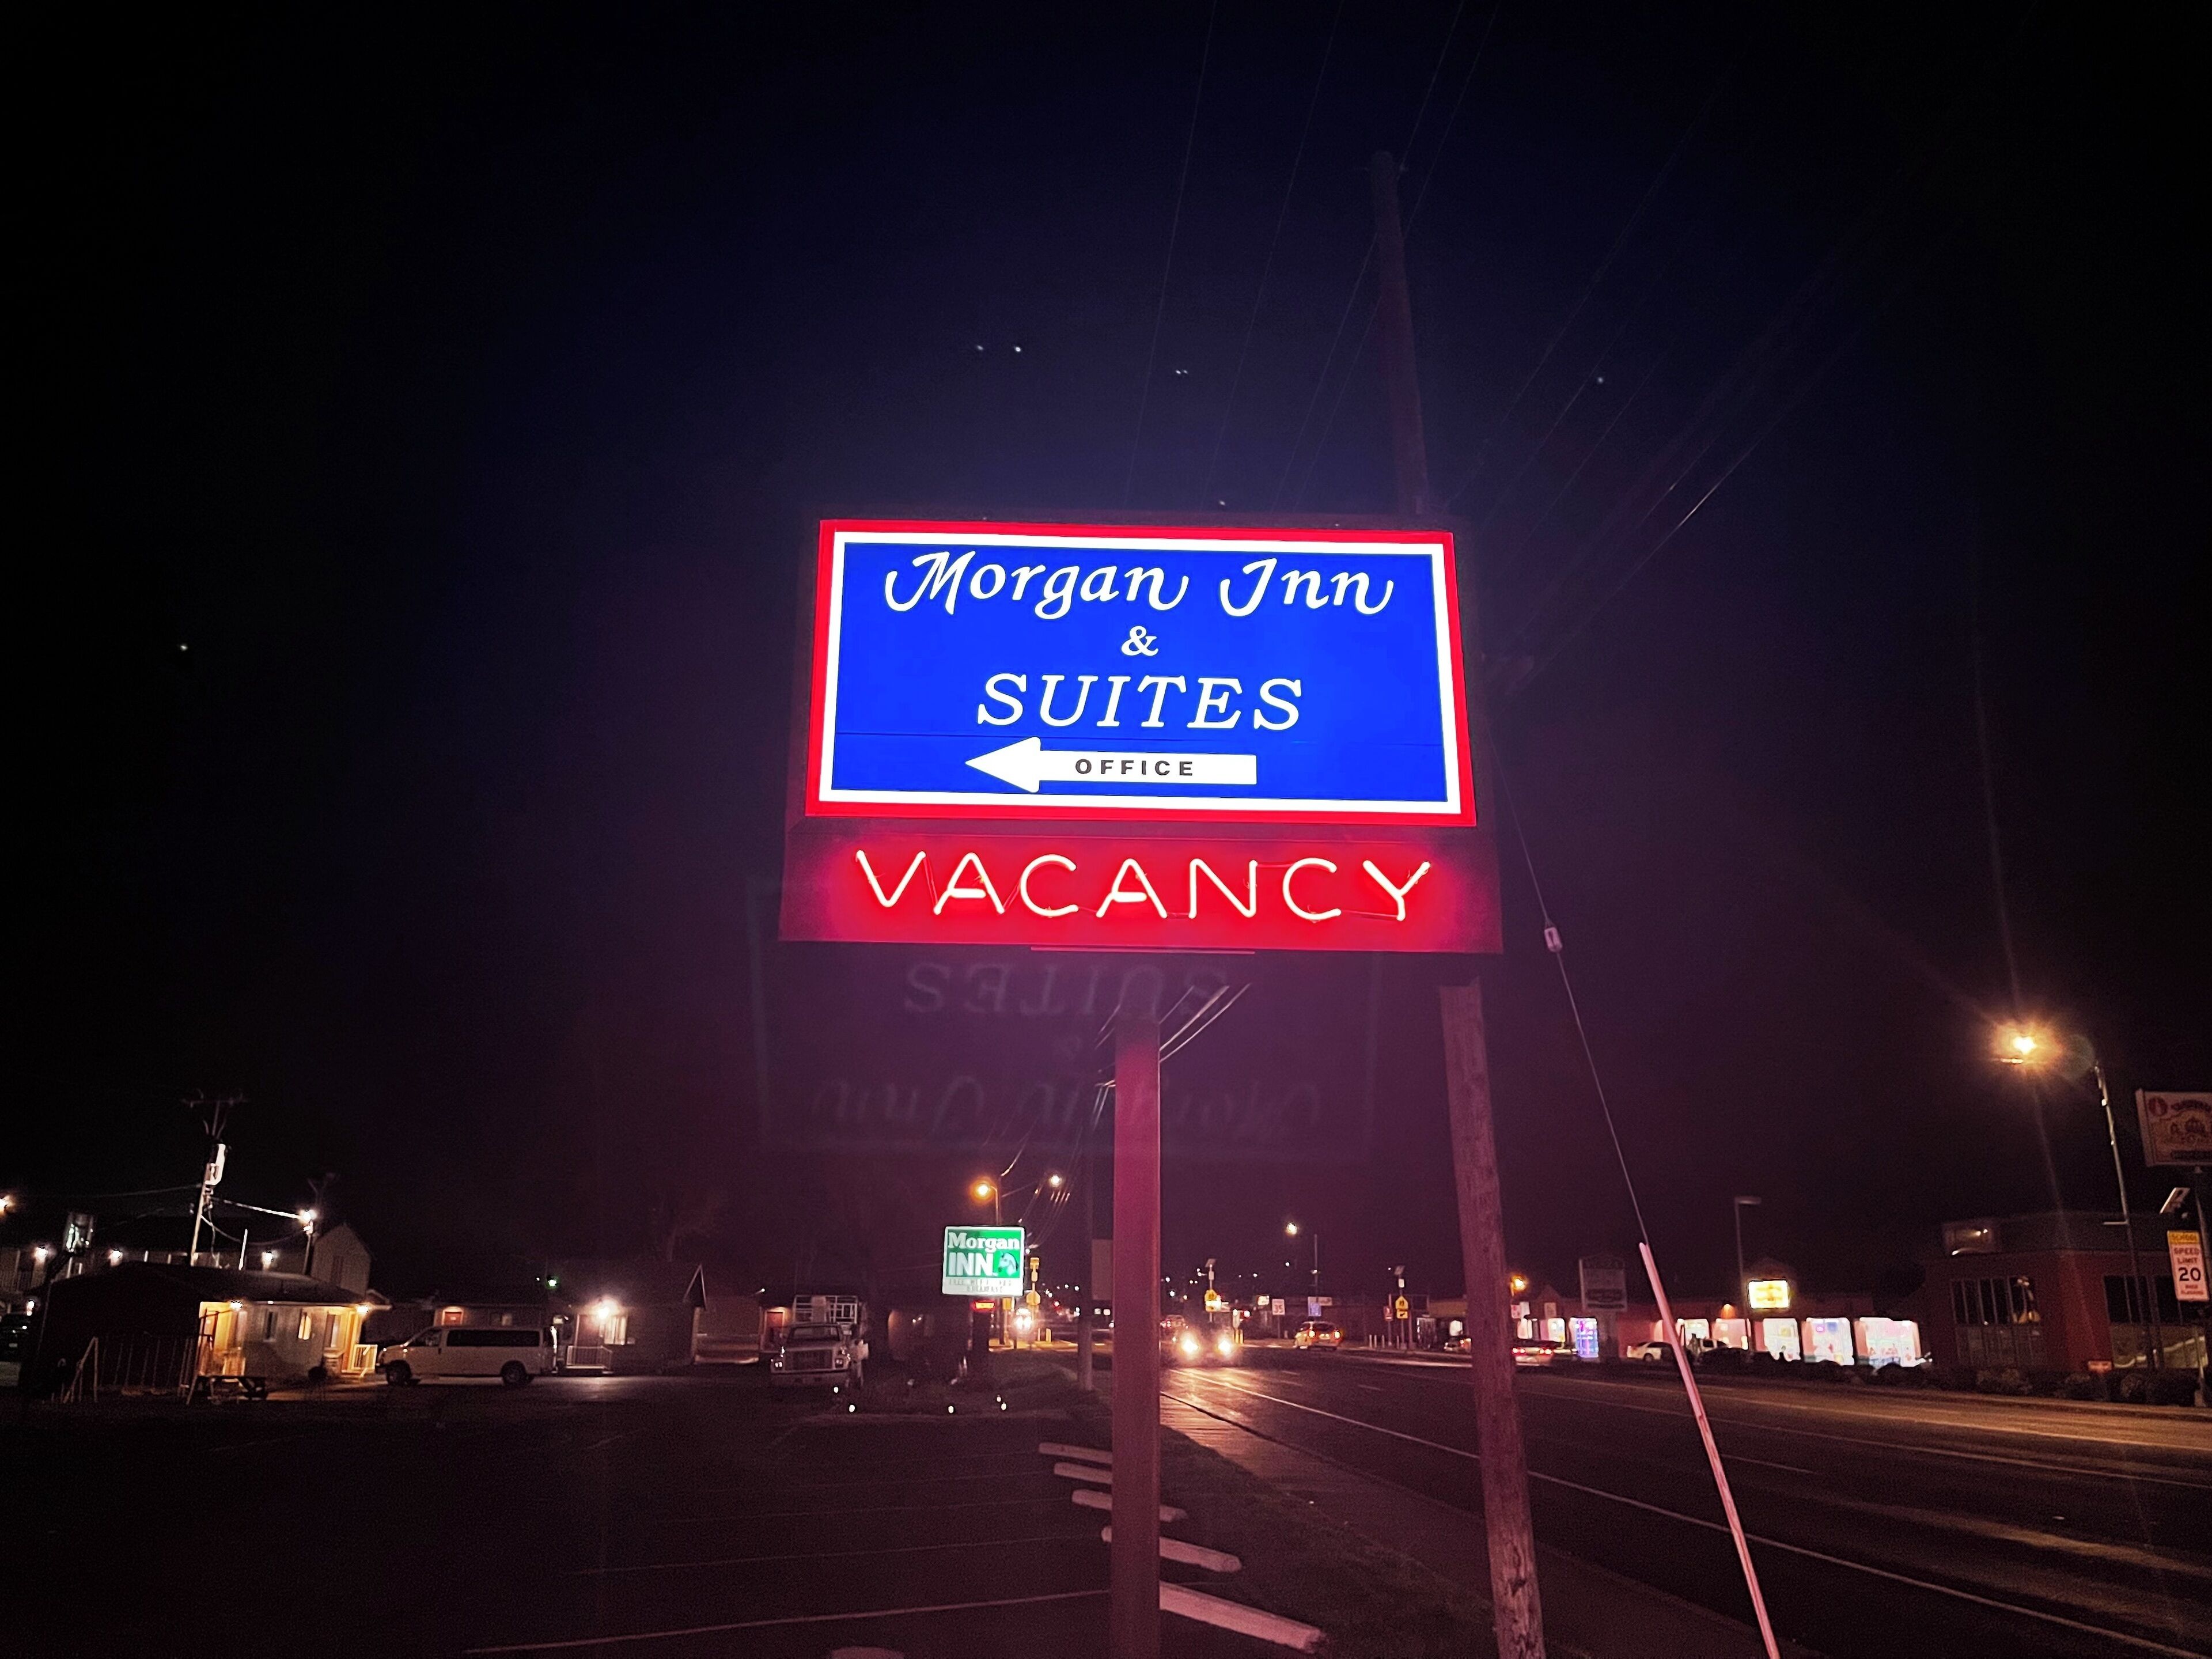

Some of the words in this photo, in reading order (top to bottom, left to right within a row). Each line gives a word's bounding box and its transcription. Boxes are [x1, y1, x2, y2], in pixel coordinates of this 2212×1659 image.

[885, 551, 1188, 619] Morgan
[1220, 557, 1395, 617] Inn
[1121, 626, 1159, 656] &
[978, 673, 1302, 730] SUITES
[1075, 759, 1194, 777] OFFICE
[855, 850, 1431, 922] VACANCY
[948, 1232, 1020, 1252] Morgan
[948, 1252, 994, 1277] INN
[2178, 1267, 2201, 1281] 20
